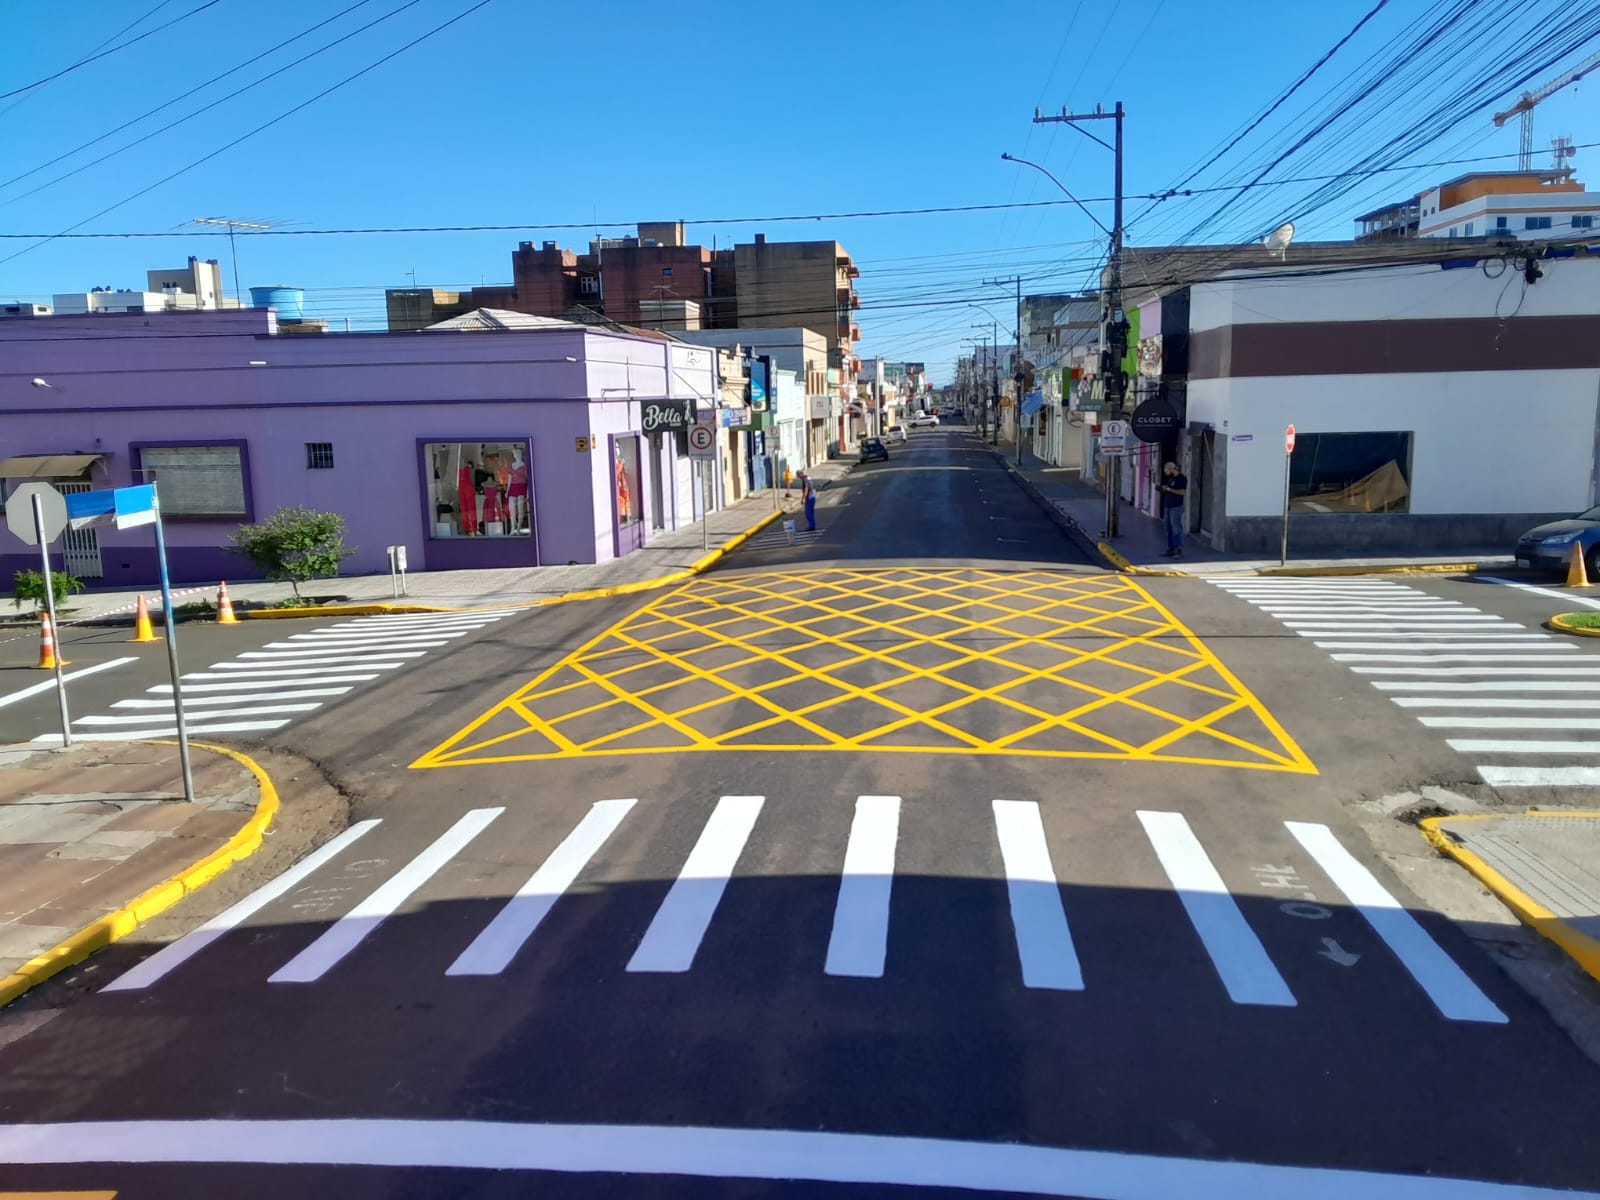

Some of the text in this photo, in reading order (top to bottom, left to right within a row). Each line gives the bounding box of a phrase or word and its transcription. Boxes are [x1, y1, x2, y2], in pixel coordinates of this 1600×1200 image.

[643, 404, 683, 431] Bella
[1137, 416, 1172, 424] CLOSET
[697, 431, 705, 445] E
